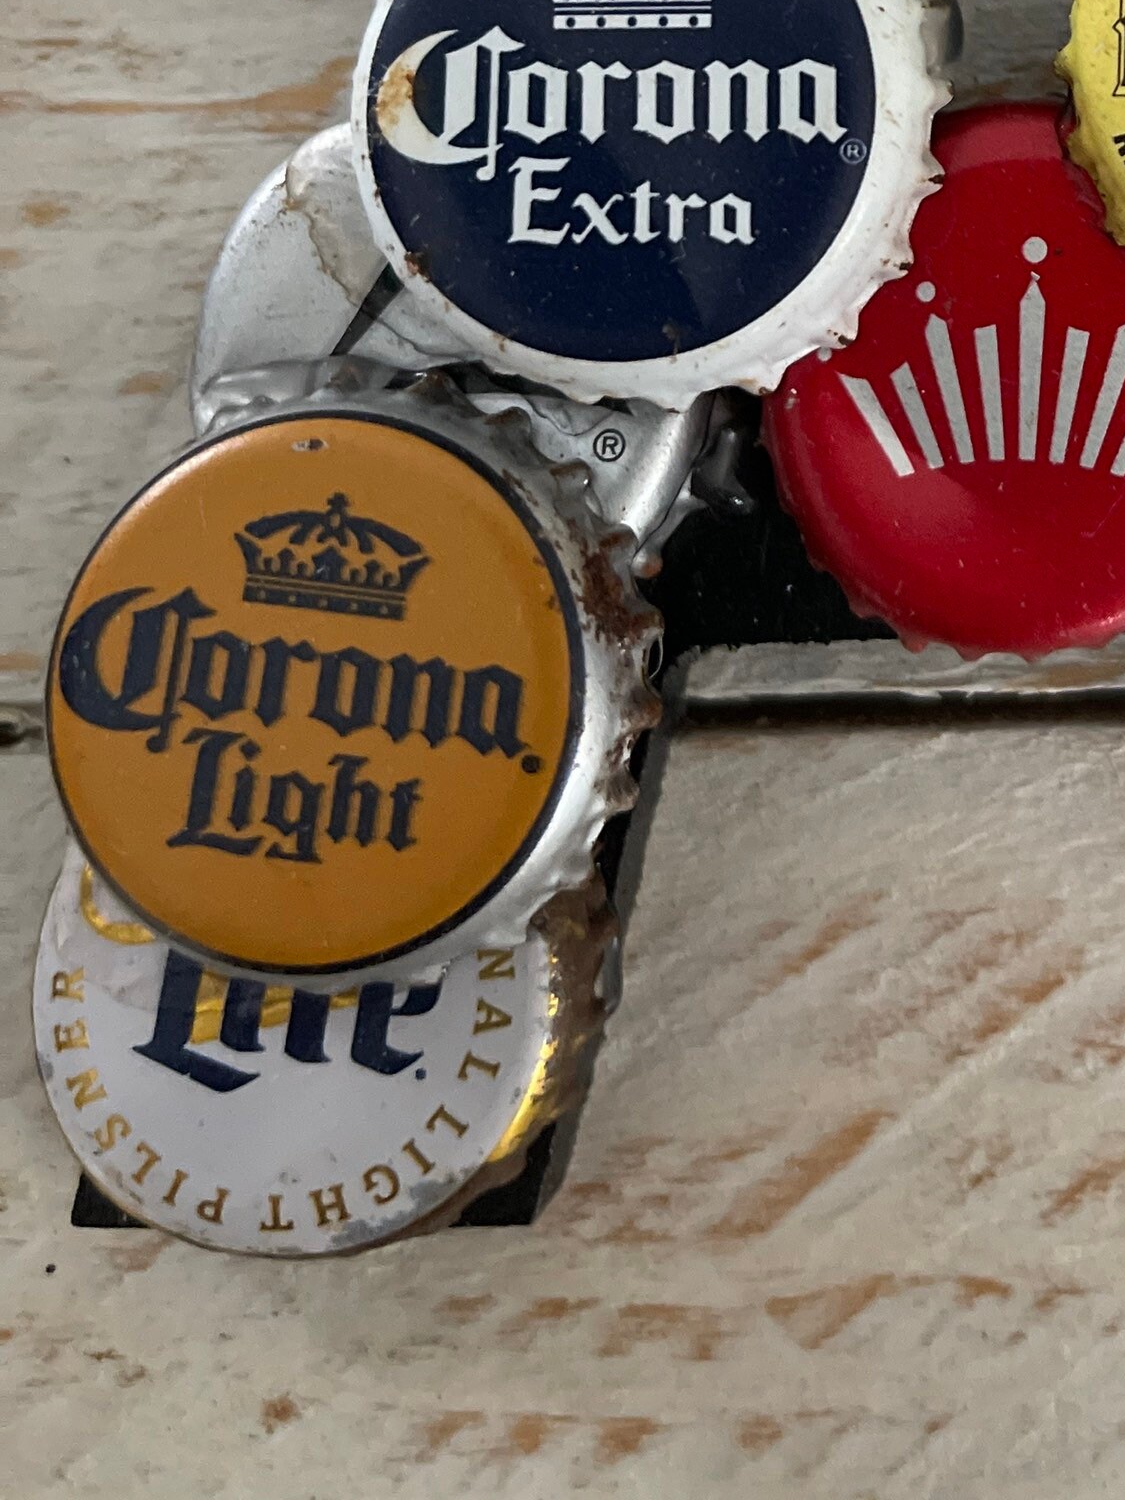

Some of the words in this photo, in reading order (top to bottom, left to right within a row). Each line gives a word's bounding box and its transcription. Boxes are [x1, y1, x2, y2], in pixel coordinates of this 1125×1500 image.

[376, 25, 848, 182] Corona
[507, 156, 757, 246] Extra
[59, 586, 530, 761] Corona
[166, 728, 423, 865] Light
[52, 966, 231, 1225] PILSNER
[258, 1104, 470, 1233] LIGHT
